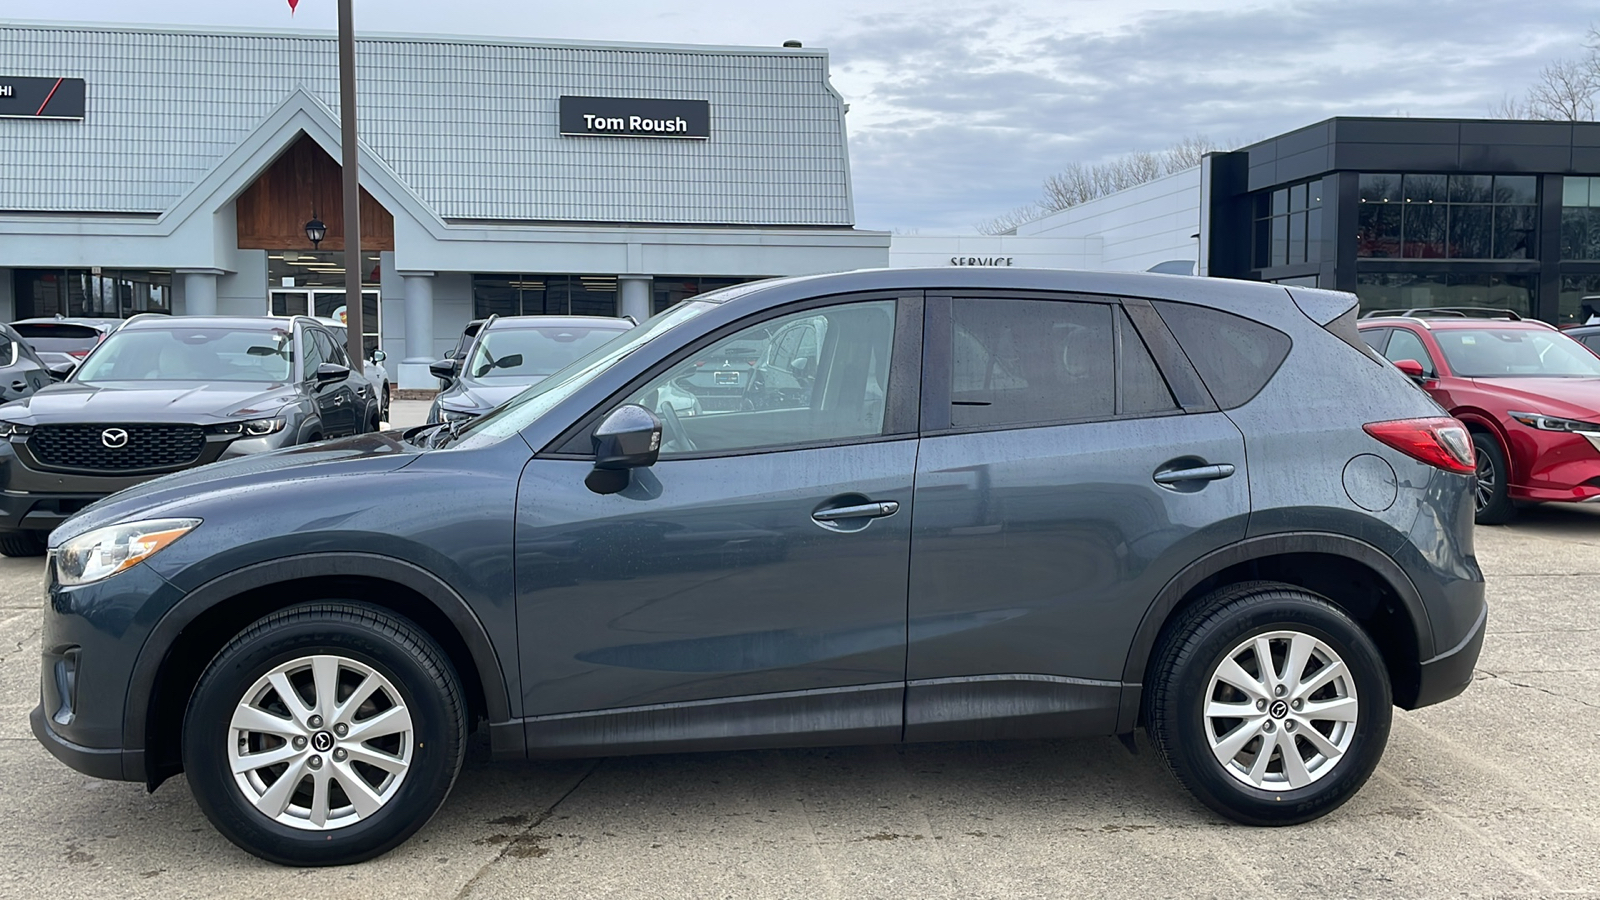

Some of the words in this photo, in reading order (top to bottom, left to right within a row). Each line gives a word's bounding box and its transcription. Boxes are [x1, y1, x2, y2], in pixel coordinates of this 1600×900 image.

[583, 114, 625, 130] Tom
[629, 115, 688, 132] Roush
[950, 256, 1014, 267] SERVICE
